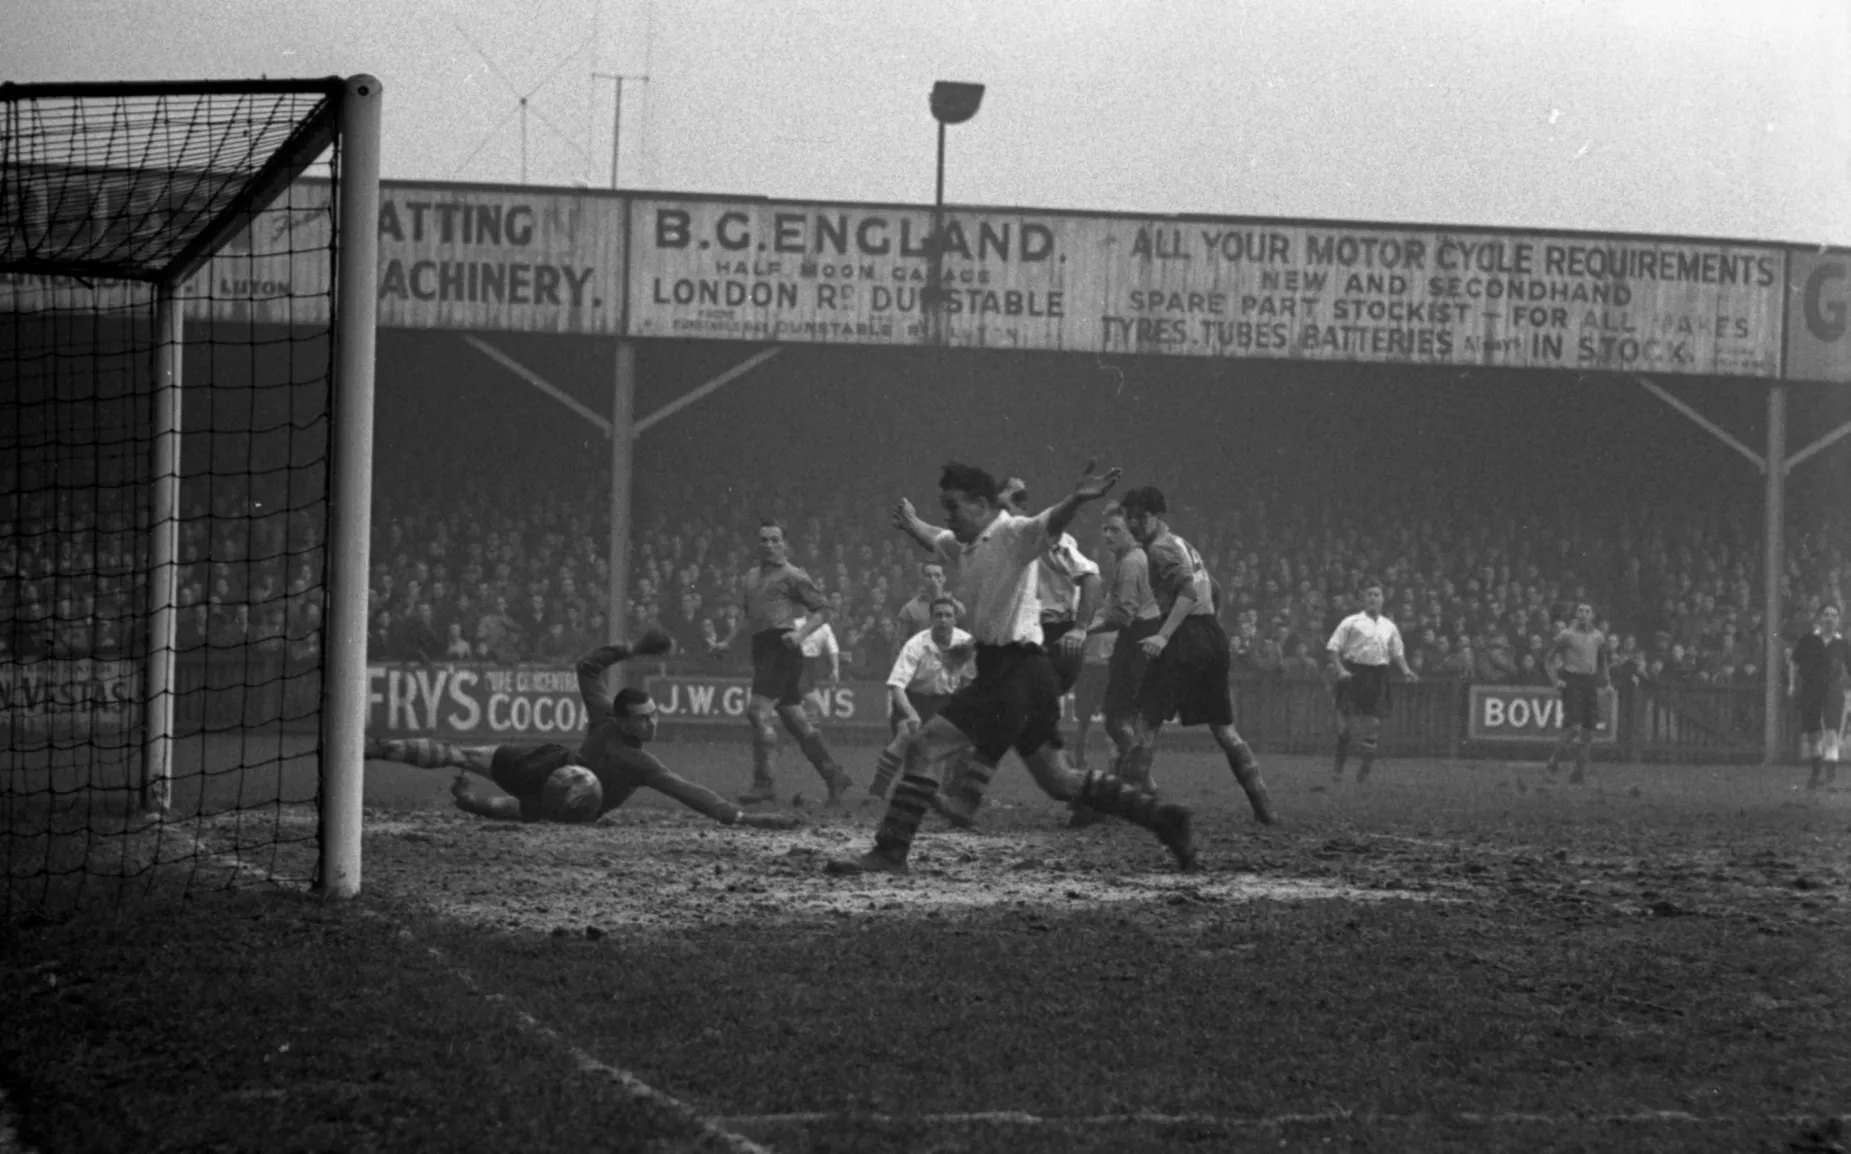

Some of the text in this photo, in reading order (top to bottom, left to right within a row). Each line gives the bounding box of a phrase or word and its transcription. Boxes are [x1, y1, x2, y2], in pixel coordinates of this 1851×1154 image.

[378, 199, 533, 246] ATTING
[716, 260, 990, 285] HALF MOON GAAGE
[1130, 226, 1774, 288] ALL YOUR MOTOR CYCLE REQUIREMENTS
[378, 258, 603, 308] ACHINERY.
[653, 277, 798, 309] LONDON
[872, 285, 1064, 318] DUSTABLE
[1261, 270, 1633, 307] NEW AND SECONDHAND
[1129, 289, 1225, 316] SPARE
[1241, 294, 1321, 319] PART
[1332, 298, 1472, 325] STOCKIST
[1512, 305, 1569, 330] FOR
[1583, 310, 1638, 335] ALL
[1301, 323, 1453, 355] BATTERIES
[1531, 332, 1563, 361] IN
[366, 666, 479, 731] FRY'S
